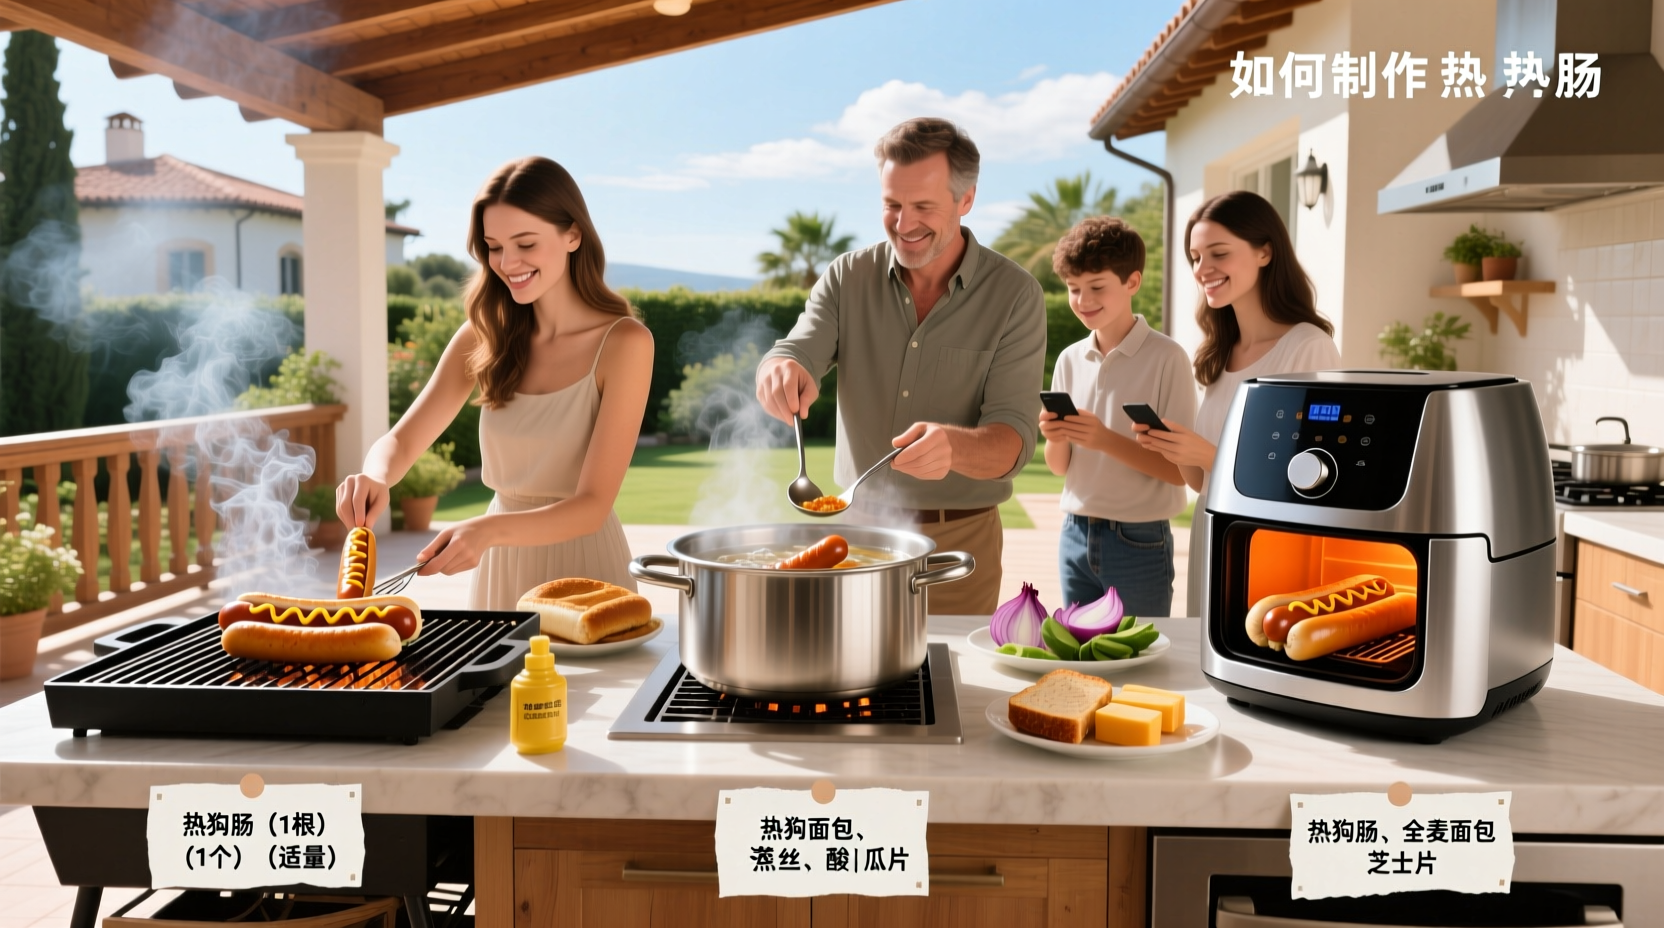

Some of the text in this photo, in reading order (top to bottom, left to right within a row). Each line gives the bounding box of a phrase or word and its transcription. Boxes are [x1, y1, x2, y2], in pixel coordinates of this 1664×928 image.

[760, 815, 864, 841] 热狗面包、
[1307, 818, 1496, 844] 热狗肠、全麦面包
[1367, 850, 1437, 875] 芝士片
